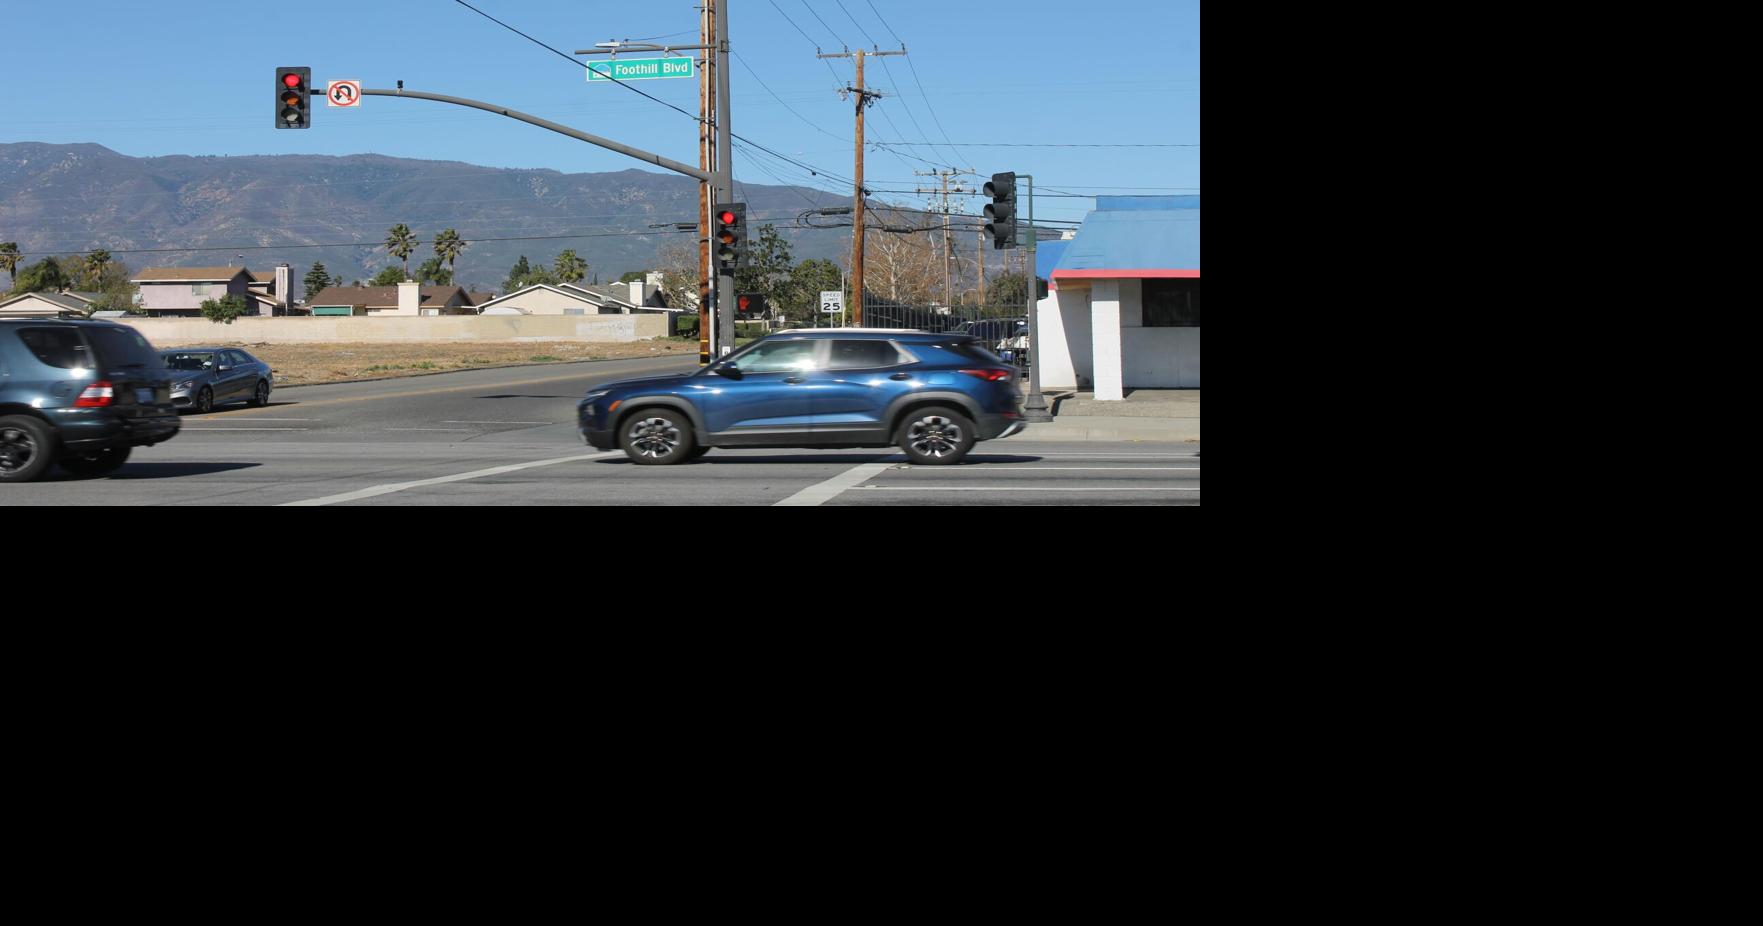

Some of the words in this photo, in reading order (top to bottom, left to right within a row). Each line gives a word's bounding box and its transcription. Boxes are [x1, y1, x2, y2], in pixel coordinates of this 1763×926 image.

[615, 63, 658, 75] Foothill
[663, 62, 688, 73] Blvd
[823, 302, 841, 311] 25
